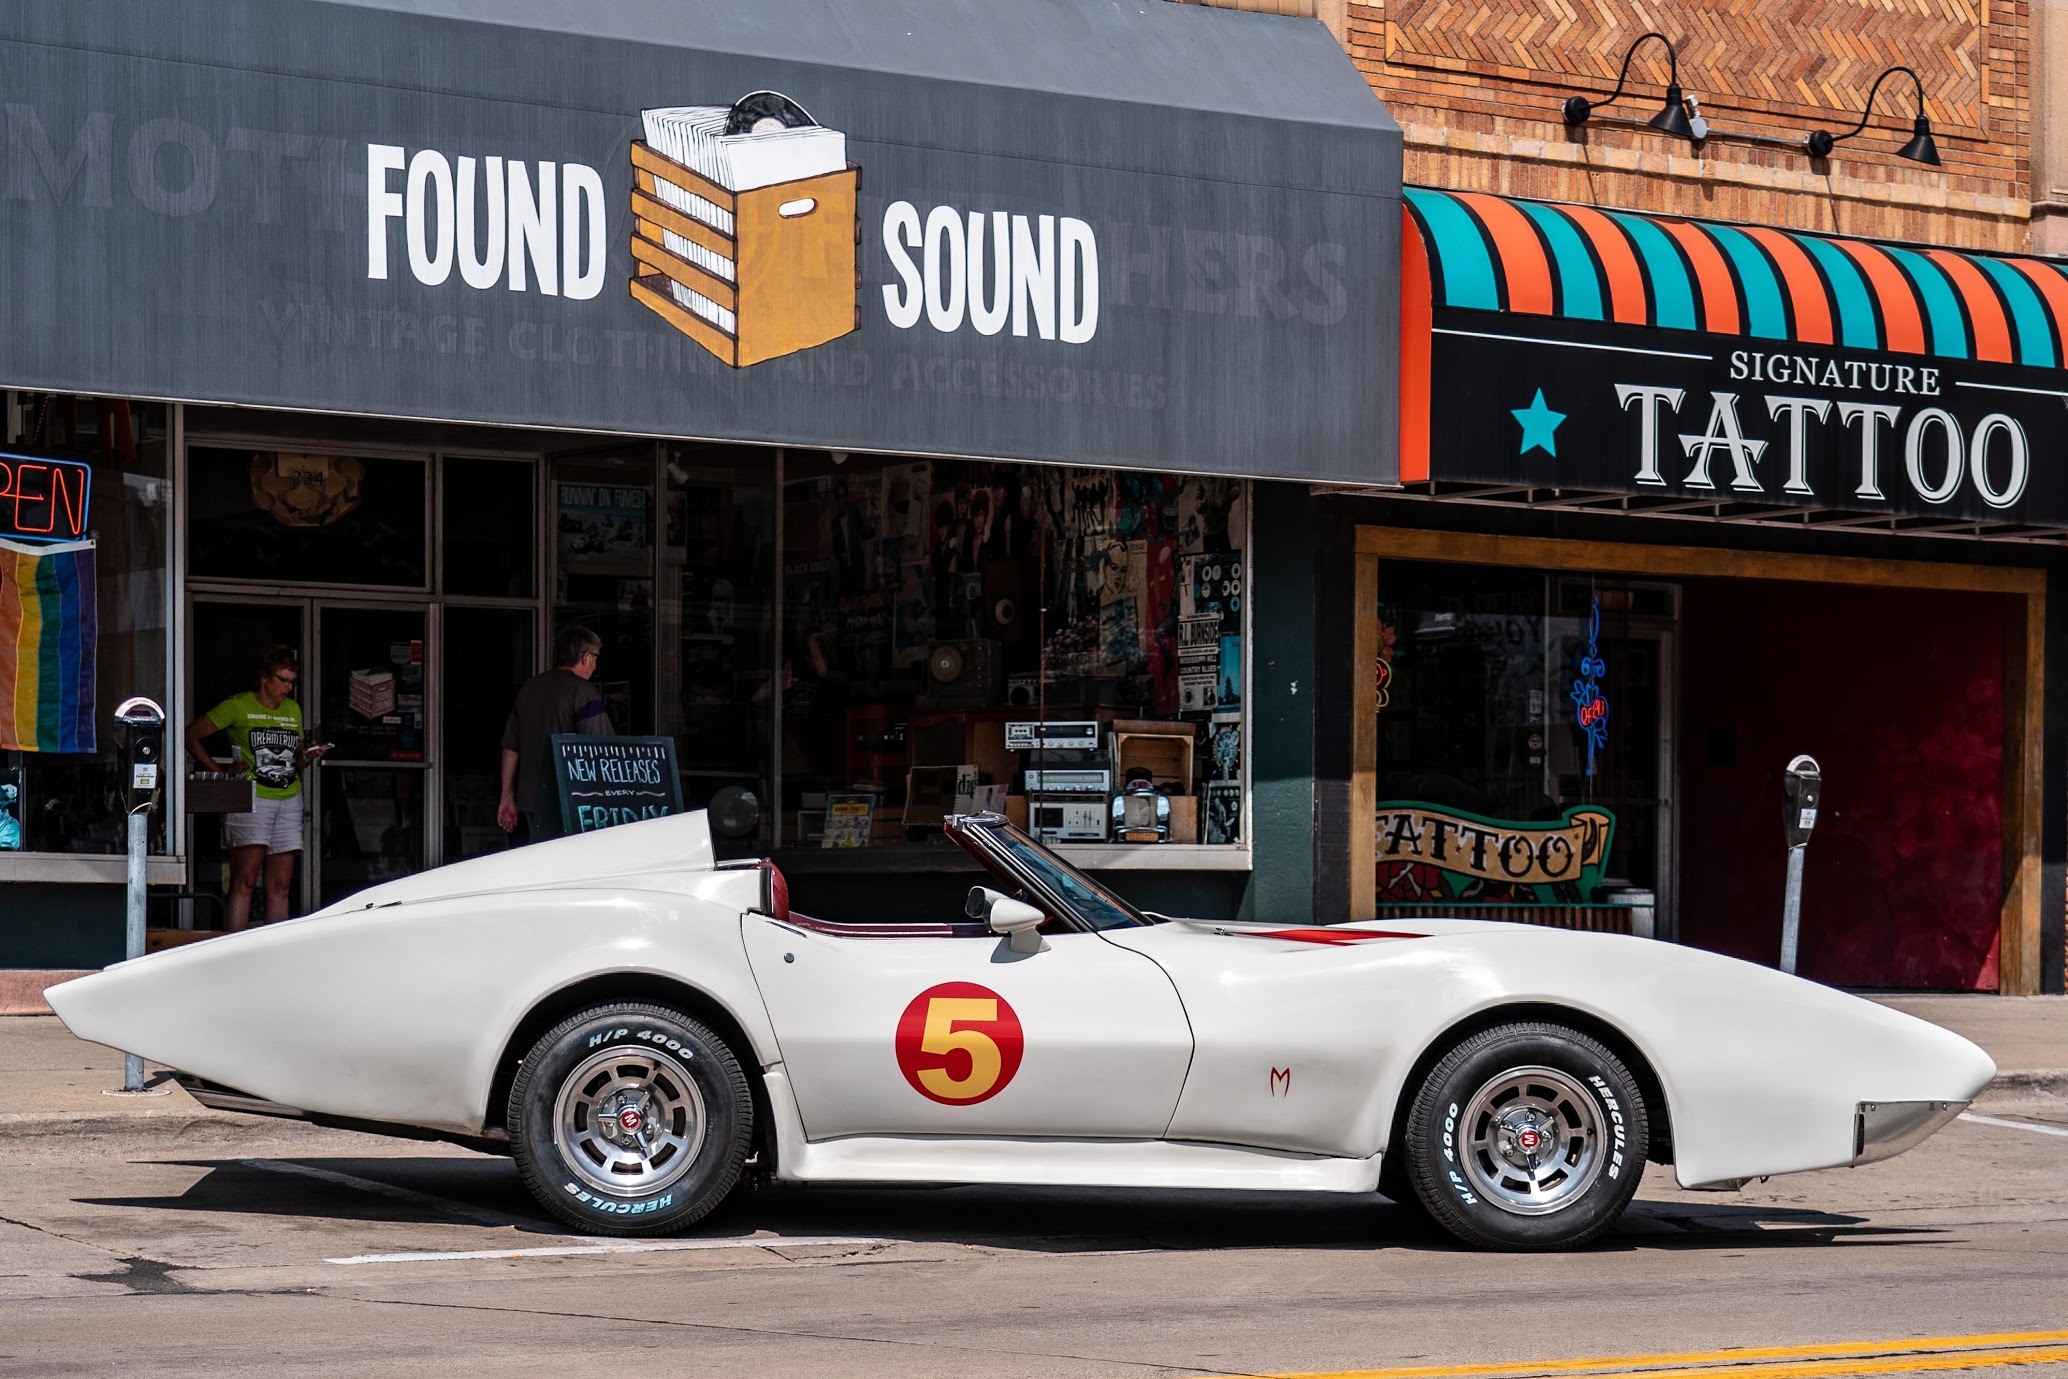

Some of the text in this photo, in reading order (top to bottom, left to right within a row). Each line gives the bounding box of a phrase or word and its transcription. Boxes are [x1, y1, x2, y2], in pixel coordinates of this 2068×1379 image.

[366, 143, 1100, 344] FOUND SOUND
[508, 320, 752, 379] CLOTHIN
[1730, 350, 1941, 396] SIGNATURE
[1614, 383, 2030, 510] TATTOO
[292, 468, 324, 486] 234
[599, 488, 611, 507] ON
[250, 731, 300, 750] DREAM CRUIS
[567, 757, 661, 785] NEW RELEASES
[605, 789, 636, 797] EVERY
[588, 1028, 694, 1060] H/P 4000
[916, 997, 1002, 1099] 5
[1269, 1065, 1292, 1099] M
[1588, 1074, 1627, 1181] HERCULES
[1442, 1102, 1479, 1206] H/P 4000
[563, 1181, 673, 1216] HERCULES
